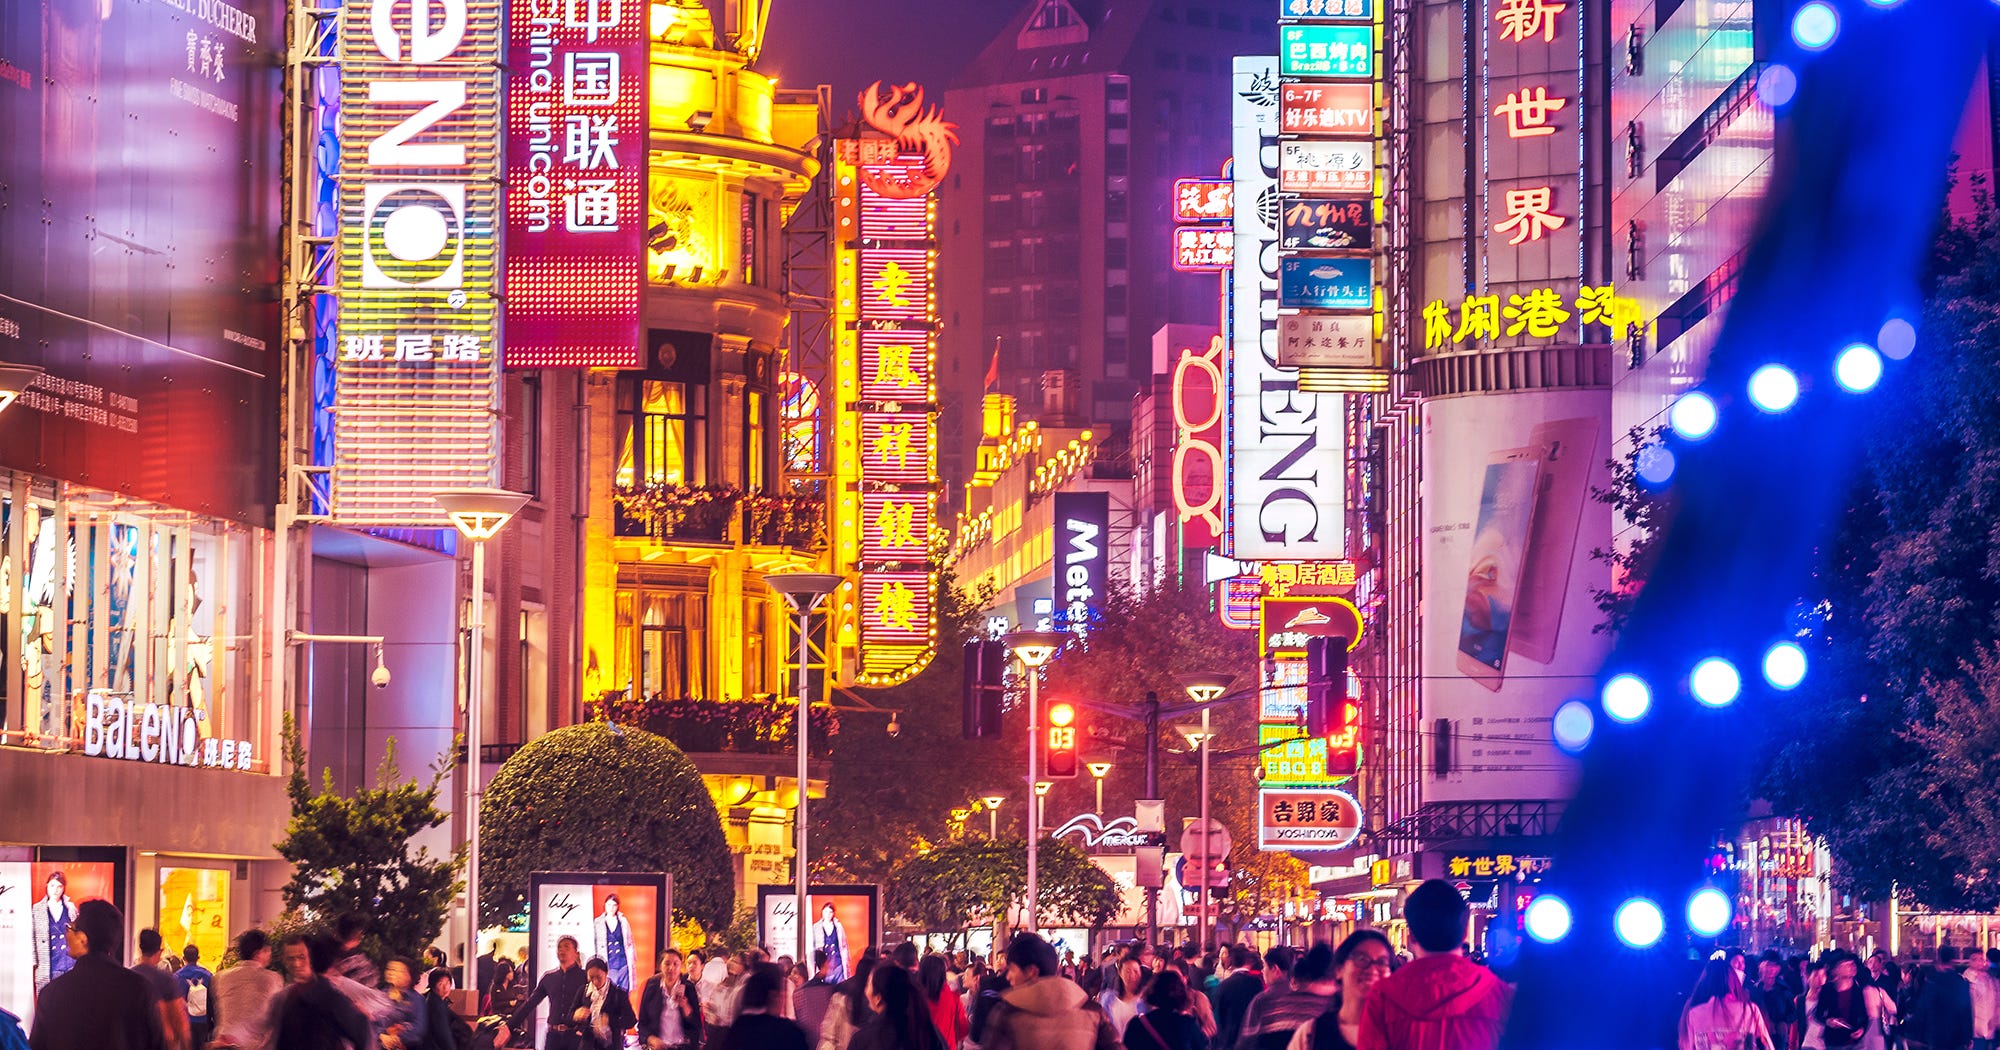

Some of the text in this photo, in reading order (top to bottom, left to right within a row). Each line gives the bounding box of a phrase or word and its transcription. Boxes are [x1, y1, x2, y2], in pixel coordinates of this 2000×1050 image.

[1290, 42, 1367, 60] 巴西烤肉
[562, 0, 622, 233] 中国联通
[1494, 0, 1566, 245] 新世界
[1286, 146, 1300, 155] 5F
[528, 102, 559, 232] unicom
[1284, 237, 1300, 248] 4F
[1286, 262, 1300, 271] 3F
[344, 334, 482, 362] 班尼路
[1050, 727, 1074, 749] 03
